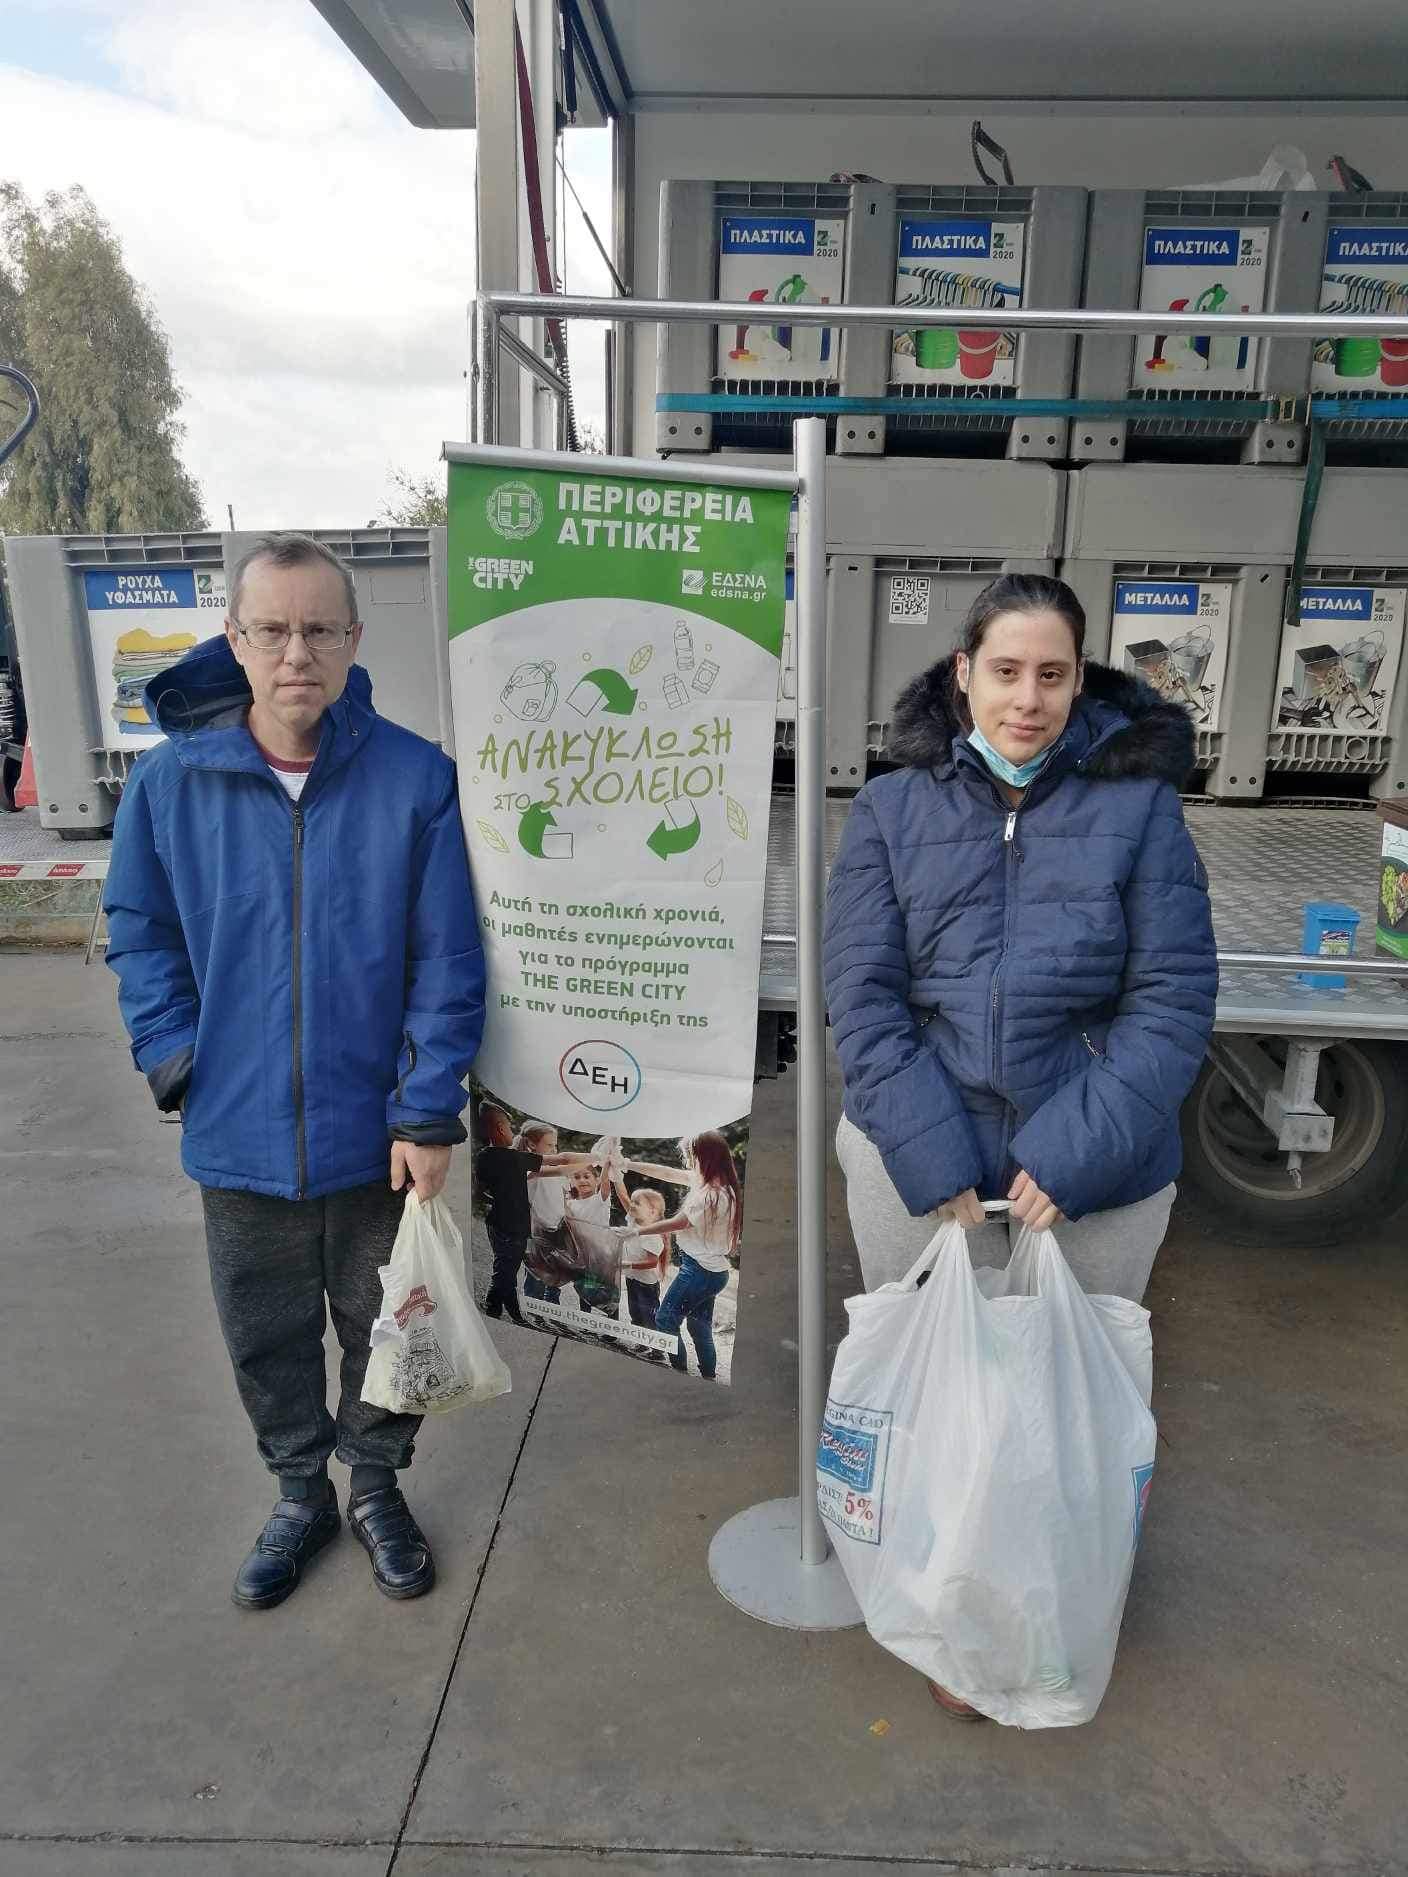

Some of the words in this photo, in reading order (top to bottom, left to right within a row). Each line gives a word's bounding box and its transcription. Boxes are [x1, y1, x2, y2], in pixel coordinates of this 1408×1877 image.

[730, 230, 806, 244] ΠΛΑΣΤΙΚΑ
[912, 235, 986, 249] ΠΛΑΣΤΙΚΑ
[816, 248, 838, 257] 2020
[993, 250, 1014, 259] 2020
[1154, 240, 1230, 254] ΠΛΑΣΤΙΚΑ
[1240, 257, 1262, 266] 2020
[558, 482, 754, 524] ΠΕΡΙΦΕΡΕΙΑ
[557, 517, 702, 553] ΑΤΤΙΚΗΣ
[475, 557, 534, 575] GREEN
[117, 575, 163, 589] ΡΟΥΧΑ
[473, 572, 524, 591] CITY
[712, 572, 767, 589] ΕΔΣΝΑ
[105, 590, 179, 605] ΥΦΑΣΜΑΤΑ
[200, 597, 227, 608] 2020
[711, 587, 767, 602] edsna.gr
[1124, 593, 1189, 606] ΜΕΤΑΛΛΑ
[1200, 608, 1219, 616] 2020
[494, 792, 531, 811] ΣΤΟ
[489, 890, 533, 914] Αυτή
[538, 902, 559, 916] τη
[566, 901, 647, 919] σχολική
[653, 905, 725, 925] χρονιά,
[483, 916, 496, 930] οι
[501, 922, 578, 942] μαθητές
[585, 931, 735, 951] ενημερώνονται
[519, 950, 548, 966] για
[555, 954, 575, 968] το
[581, 956, 689, 978] πρόγραμμα
[520, 970, 559, 991] THE
[566, 976, 634, 998] GREEN
[641, 983, 687, 1001] CITY
[500, 994, 520, 1009] με
[526, 1000, 556, 1014] την
[562, 1004, 671, 1027] υποστήριξη
[677, 1014, 709, 1028] της
[568, 1057, 628, 1095] ΔΕΗ
